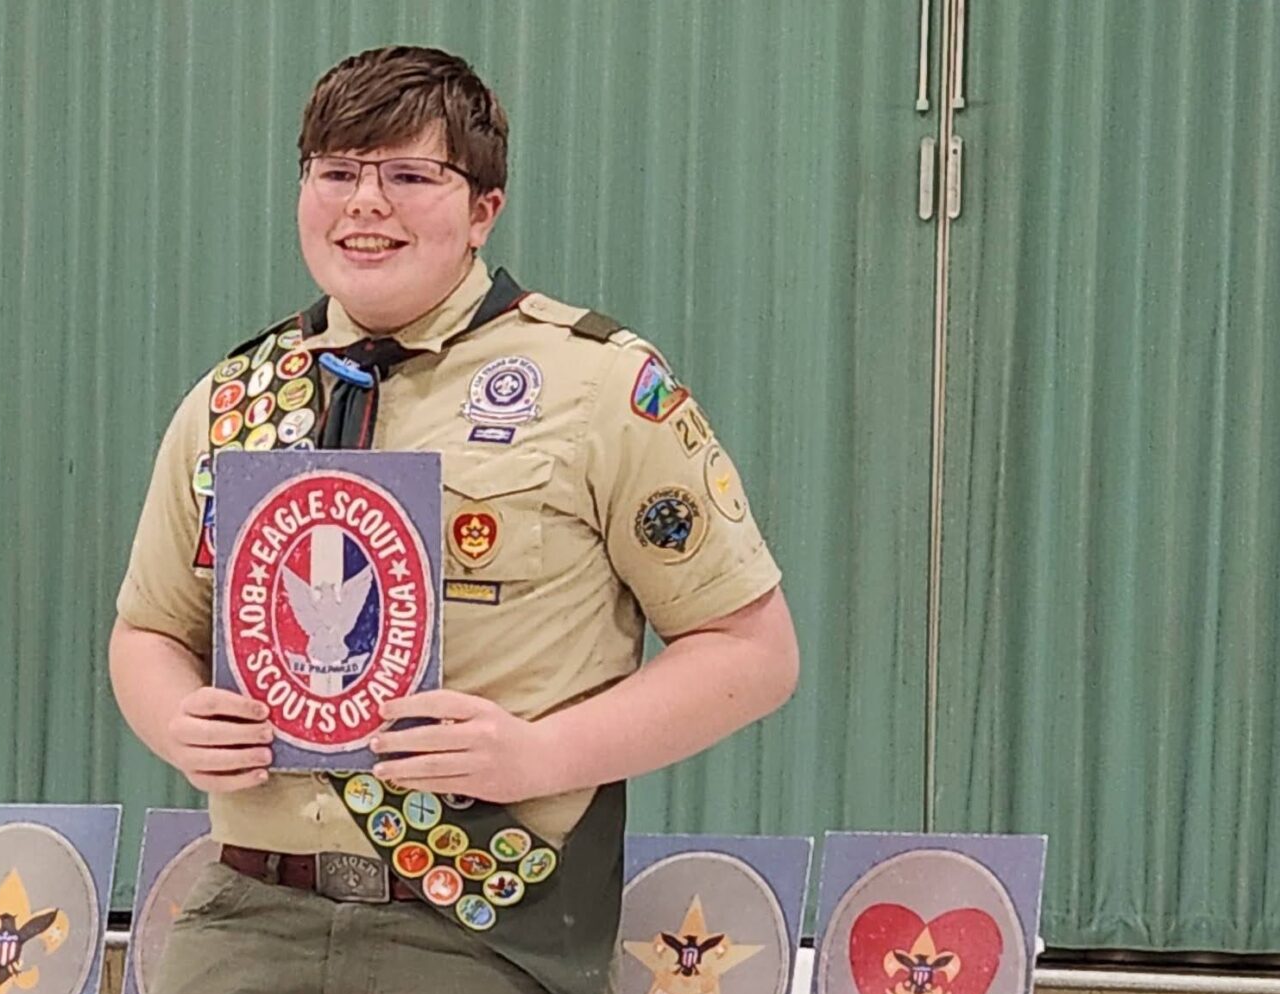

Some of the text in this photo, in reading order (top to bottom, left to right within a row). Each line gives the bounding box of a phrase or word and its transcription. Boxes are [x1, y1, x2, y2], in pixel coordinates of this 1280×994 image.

[251, 489, 407, 566] EAGLE SCOUT
[238, 581, 418, 734] BOY SCOUTS OF AMERICA
